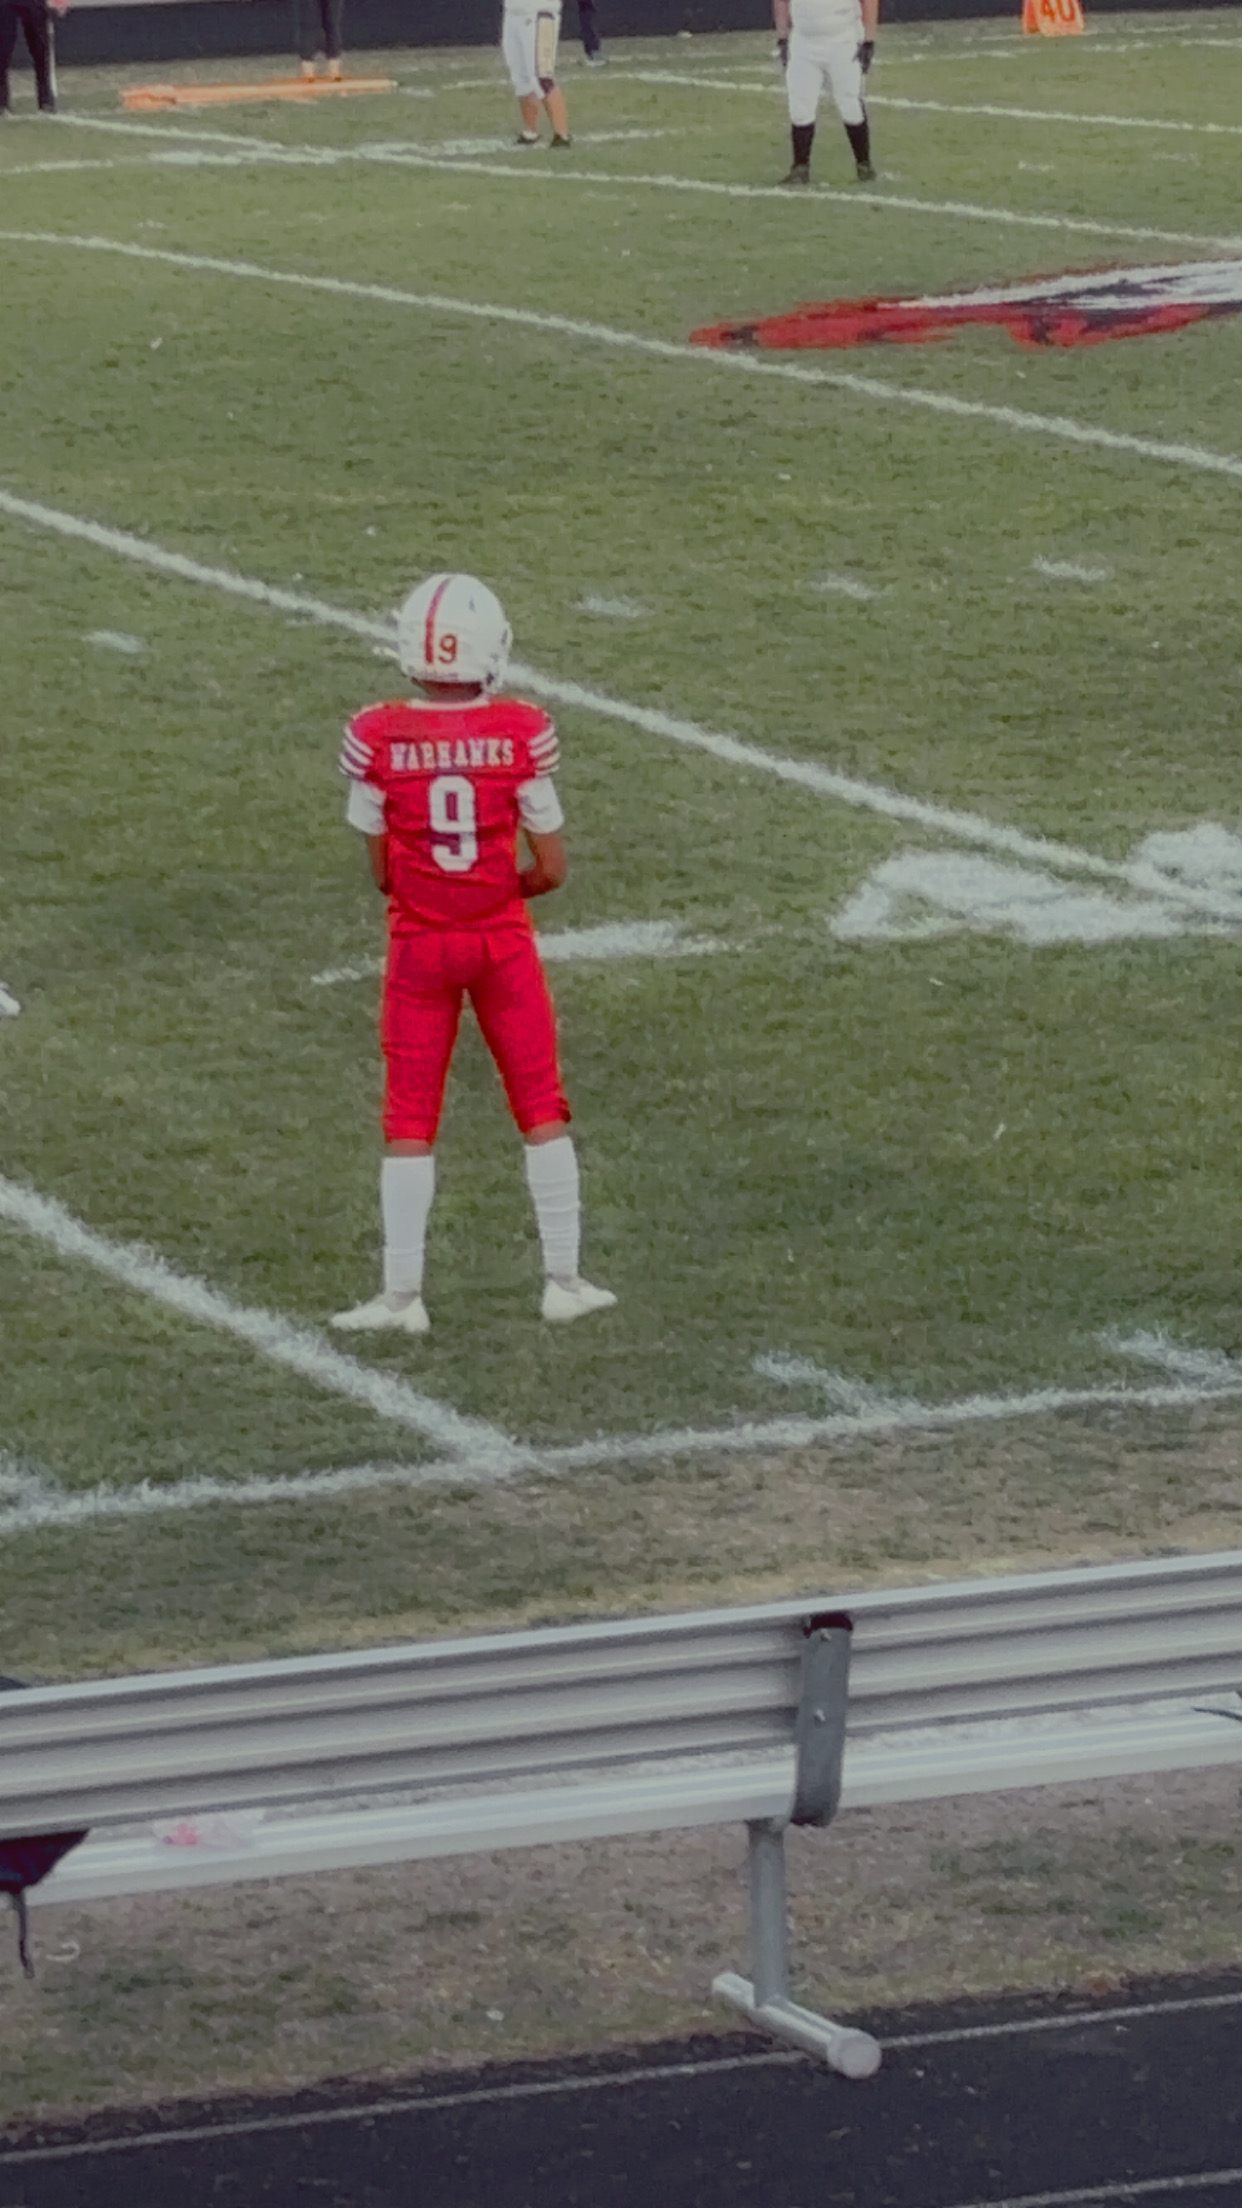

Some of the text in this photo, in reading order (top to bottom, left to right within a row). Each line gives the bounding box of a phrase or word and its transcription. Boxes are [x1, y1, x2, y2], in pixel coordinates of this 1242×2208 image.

[1039, 0, 1077, 23] 40
[438, 634, 458, 664] 9
[389, 738, 515, 771] WARHAWKS
[428, 774, 478, 872] 9
